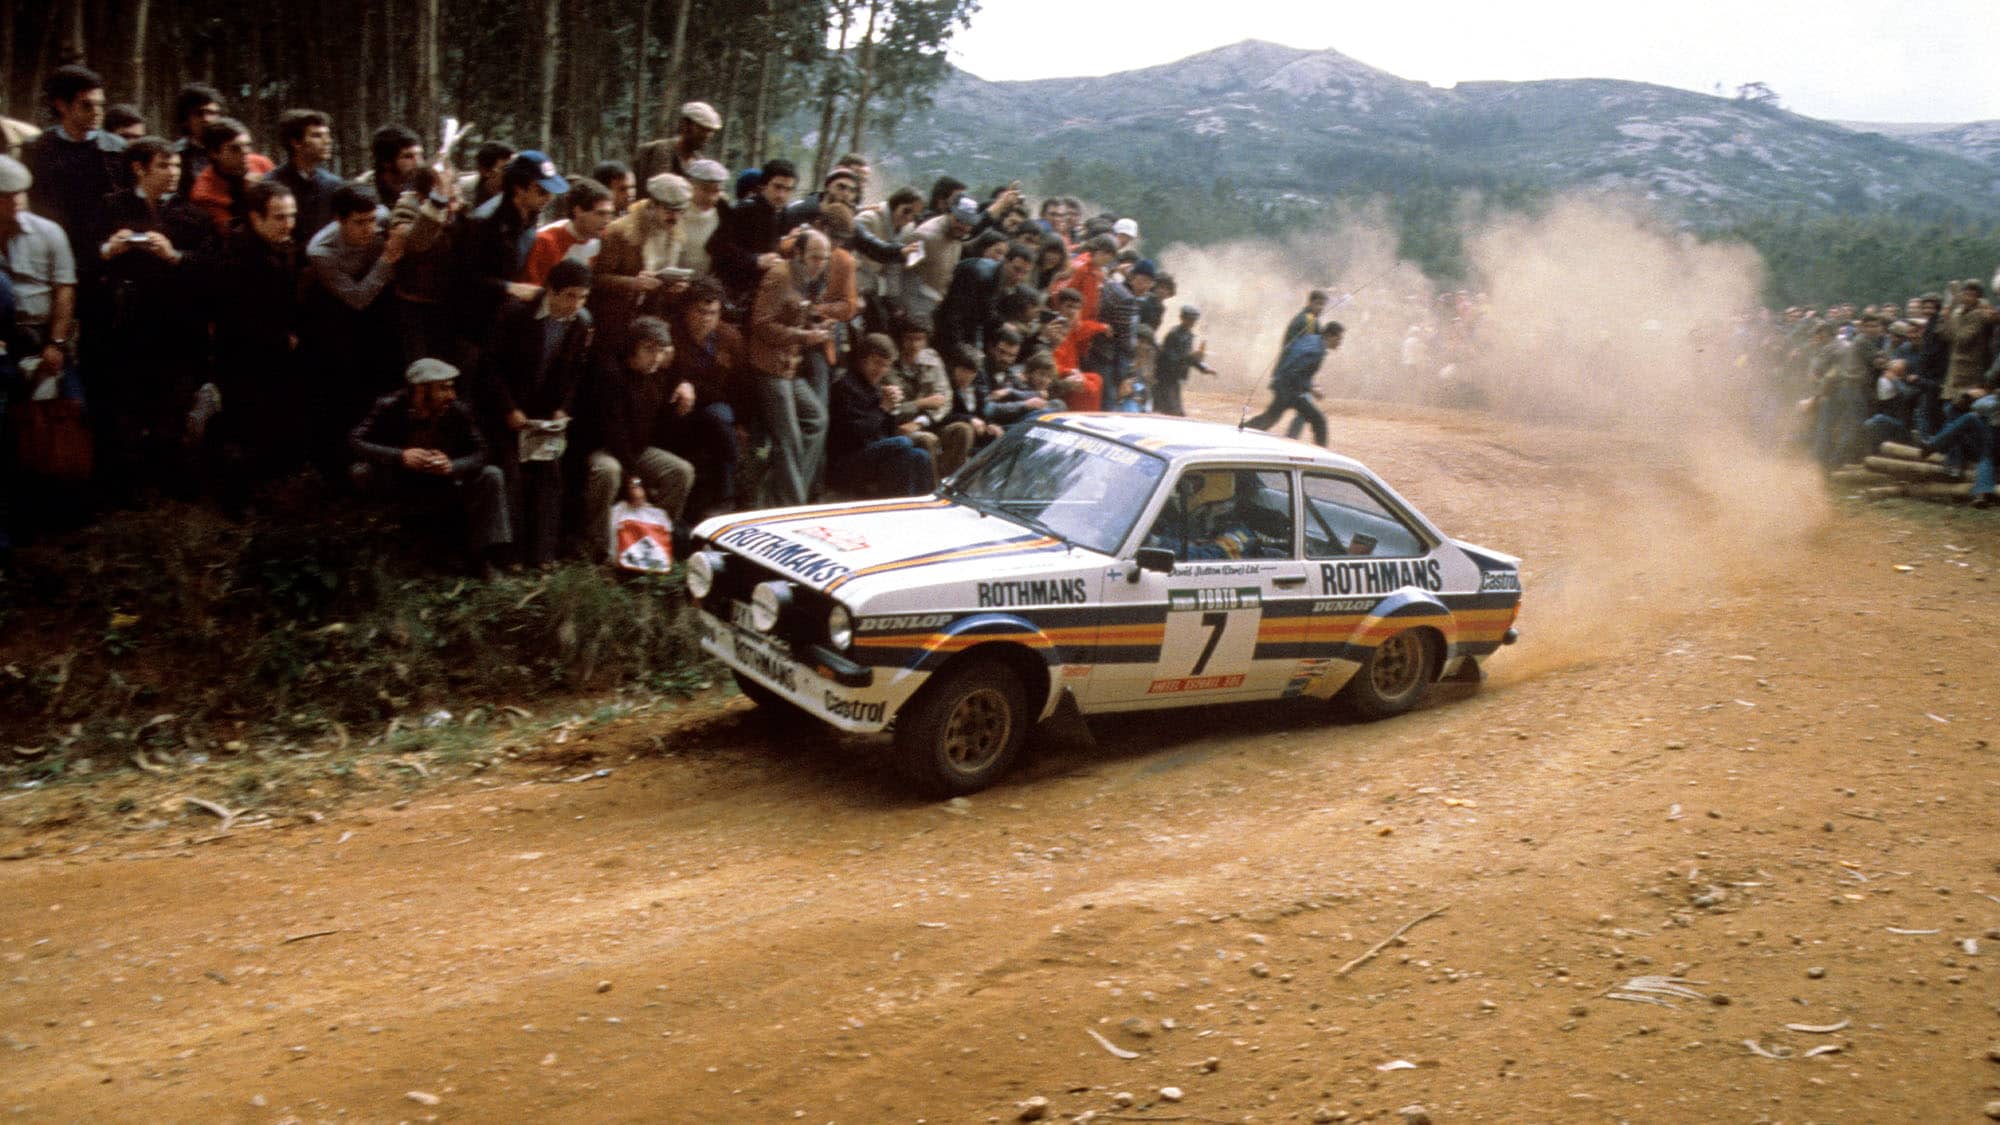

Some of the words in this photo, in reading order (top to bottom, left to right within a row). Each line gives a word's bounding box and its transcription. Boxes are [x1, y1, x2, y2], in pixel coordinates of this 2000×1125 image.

[724, 527, 850, 582] ROTHMANS
[977, 578, 1087, 607] ROTHMANS
[1321, 558, 1441, 595] ROTHMANS
[858, 615, 953, 631] DUNLOP
[1313, 601, 1376, 613] DUNLOP
[1190, 612, 1228, 676] 7
[823, 689, 886, 723] Castrol
